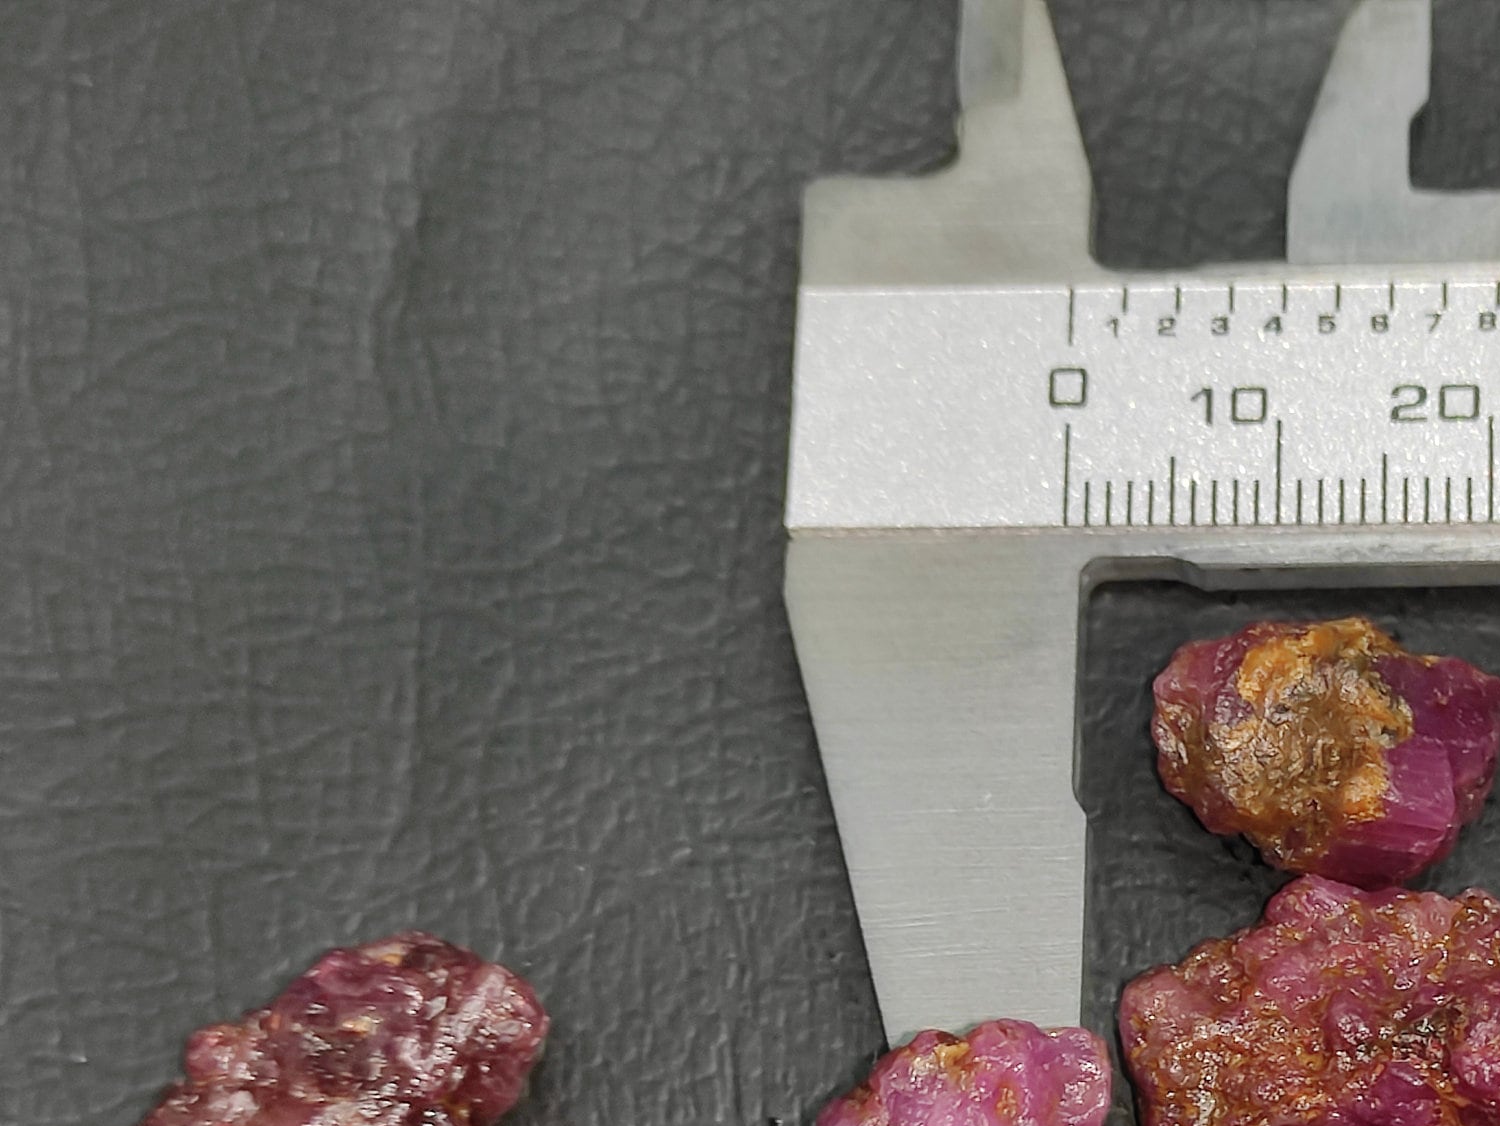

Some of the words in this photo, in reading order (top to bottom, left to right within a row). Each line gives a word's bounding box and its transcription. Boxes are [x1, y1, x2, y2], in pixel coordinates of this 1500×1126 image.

[1107, 317, 1119, 338] 1
[1157, 317, 1177, 337] 2
[1210, 316, 1230, 336] 3
[1264, 315, 1283, 336] 4
[1318, 313, 1336, 334] 5
[1371, 313, 1390, 334] 6
[1424, 313, 1442, 334] 7
[1479, 311, 1497, 331] 8
[1049, 367, 1088, 408] 0
[1190, 386, 1268, 426] 10
[1390, 384, 1481, 423] 20
